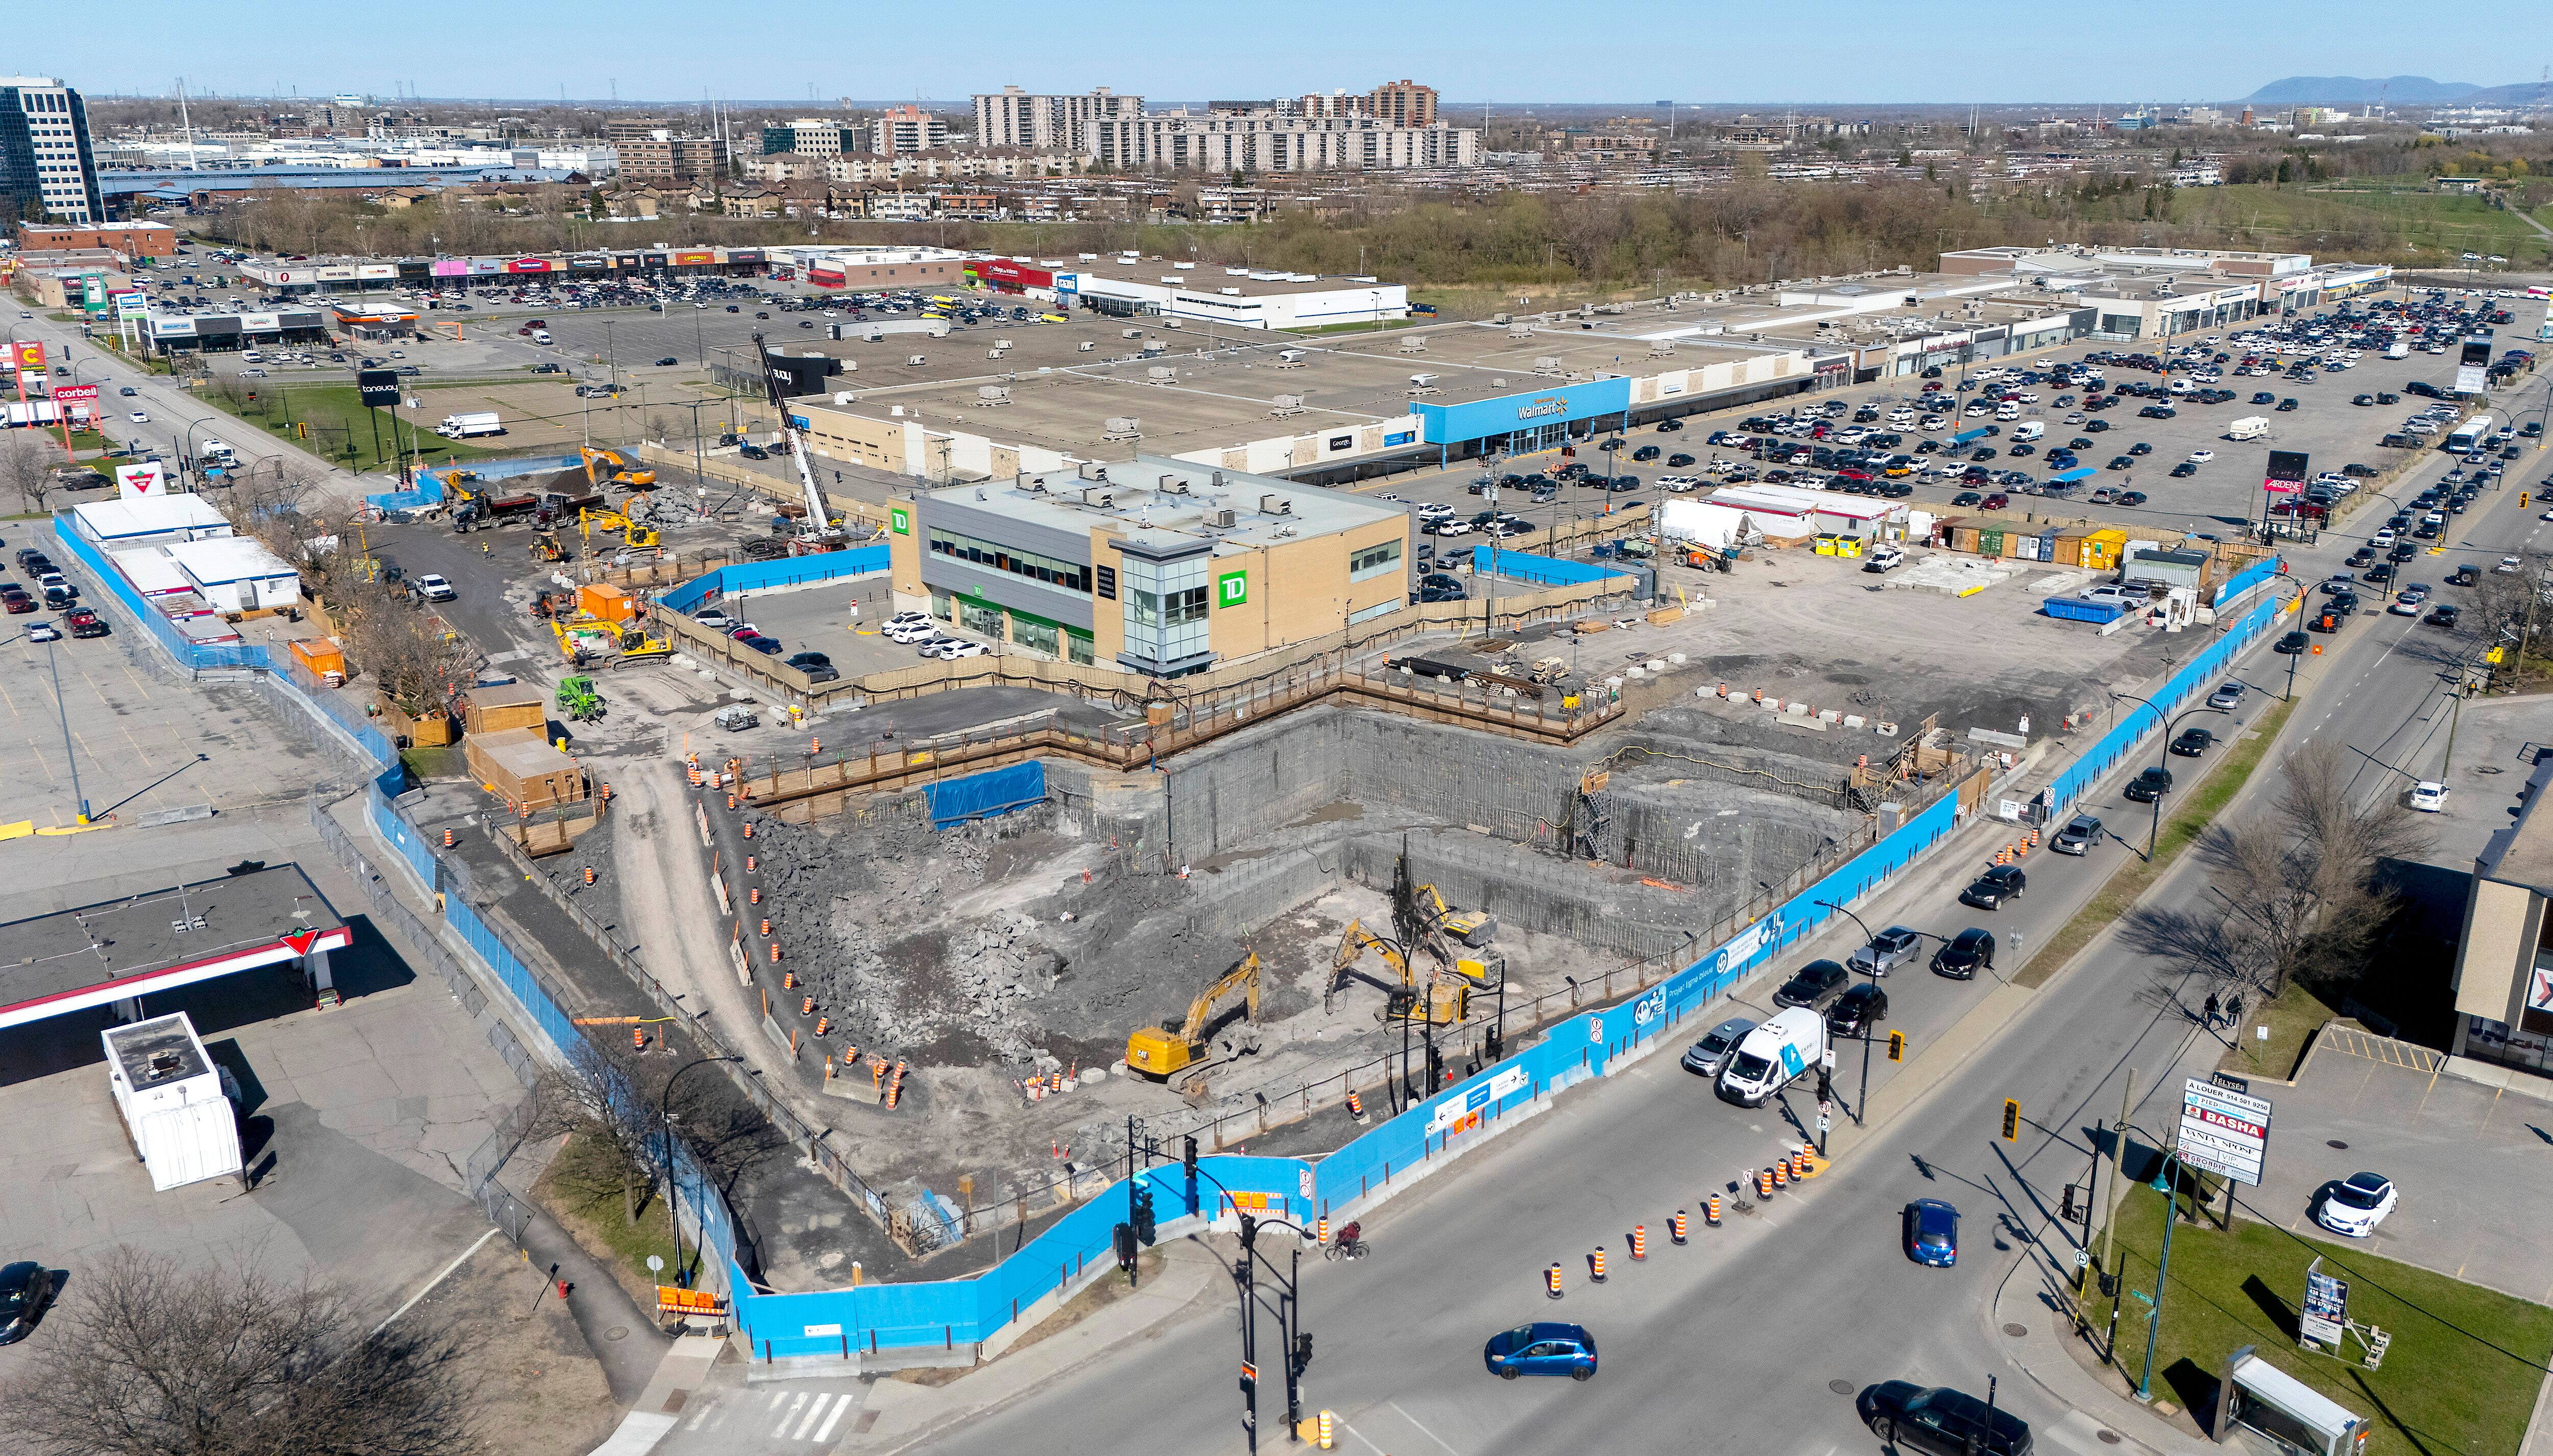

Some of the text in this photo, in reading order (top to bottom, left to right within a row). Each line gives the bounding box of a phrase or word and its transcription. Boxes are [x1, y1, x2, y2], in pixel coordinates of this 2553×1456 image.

[23, 349, 38, 363] C
[58, 387, 97, 398] corbeil
[1518, 402, 1555, 420] Walmart
[2267, 480, 2301, 490] ARDENE
[893, 513, 906, 529] TD
[1222, 577, 1244, 599] TD
[1376, 946, 1384, 954] CAT
[1669, 967, 1713, 997] Projet ligne bleue
[1138, 1050, 1147, 1058] CAT
[2218, 1078, 2245, 1090] ÉLYSÉE
[2197, 1085, 2223, 1097] LOUER
[2253, 1102, 2268, 1110] 9250
[2206, 1111, 2259, 1136] BASHA
[2186, 1129, 2255, 1155] VANIA SPOSE
[2191, 1156, 2226, 1171] GRONDIN
